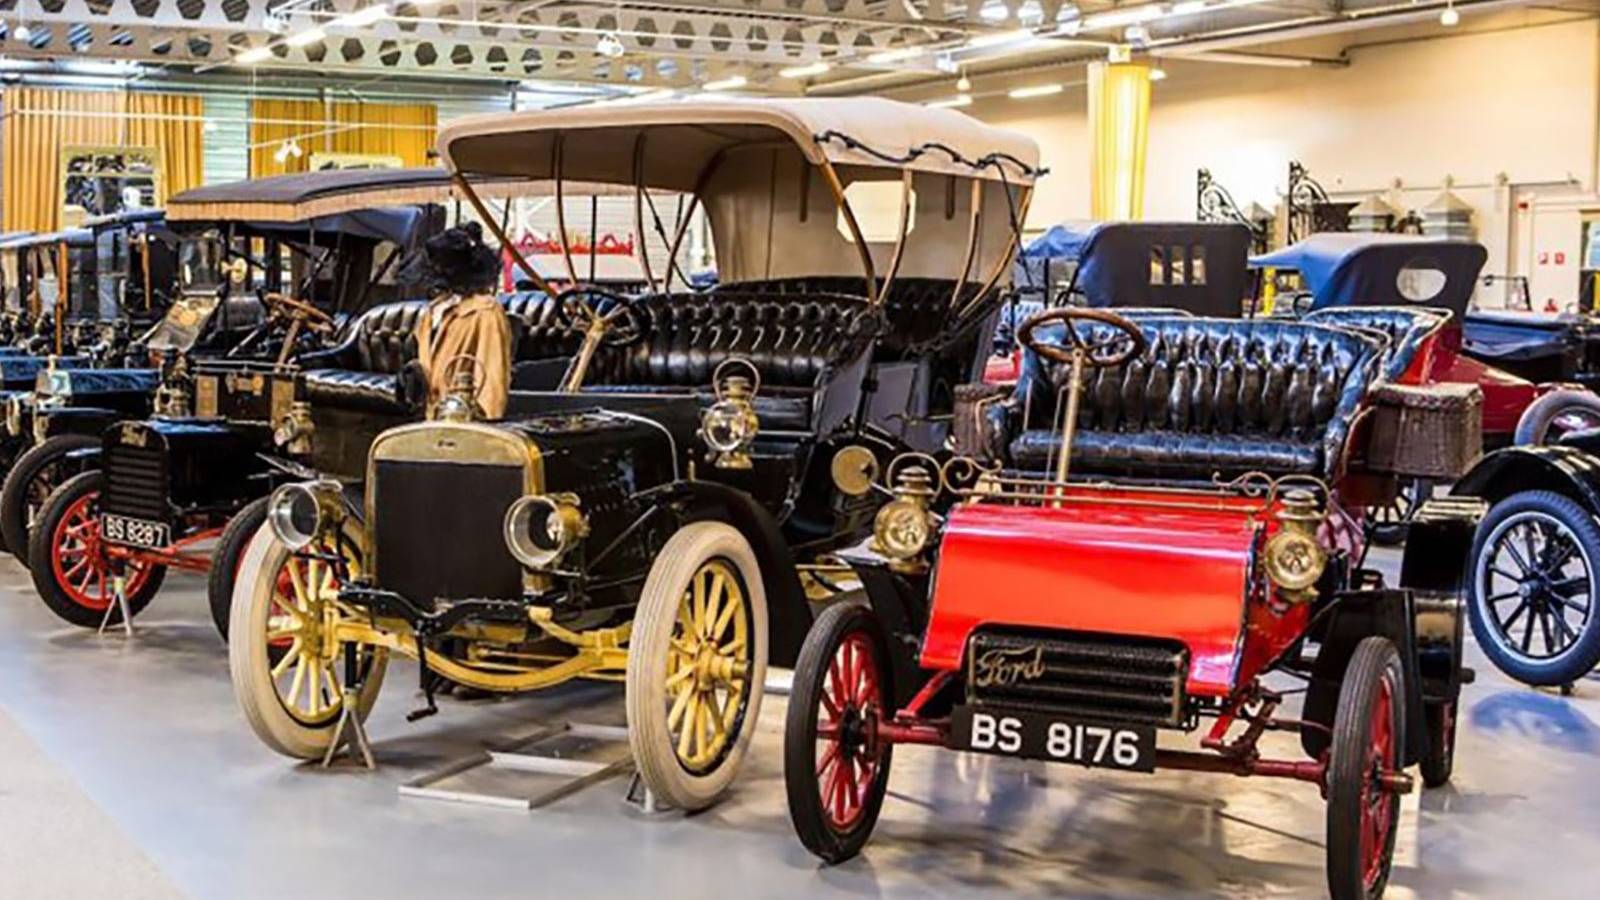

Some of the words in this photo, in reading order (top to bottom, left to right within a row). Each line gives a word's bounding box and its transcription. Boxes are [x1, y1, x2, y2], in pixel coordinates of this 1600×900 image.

[107, 516, 125, 540] BS
[976, 641, 1046, 687] Ford
[970, 713, 1022, 753] BS
[1046, 722, 1140, 766] 8176
